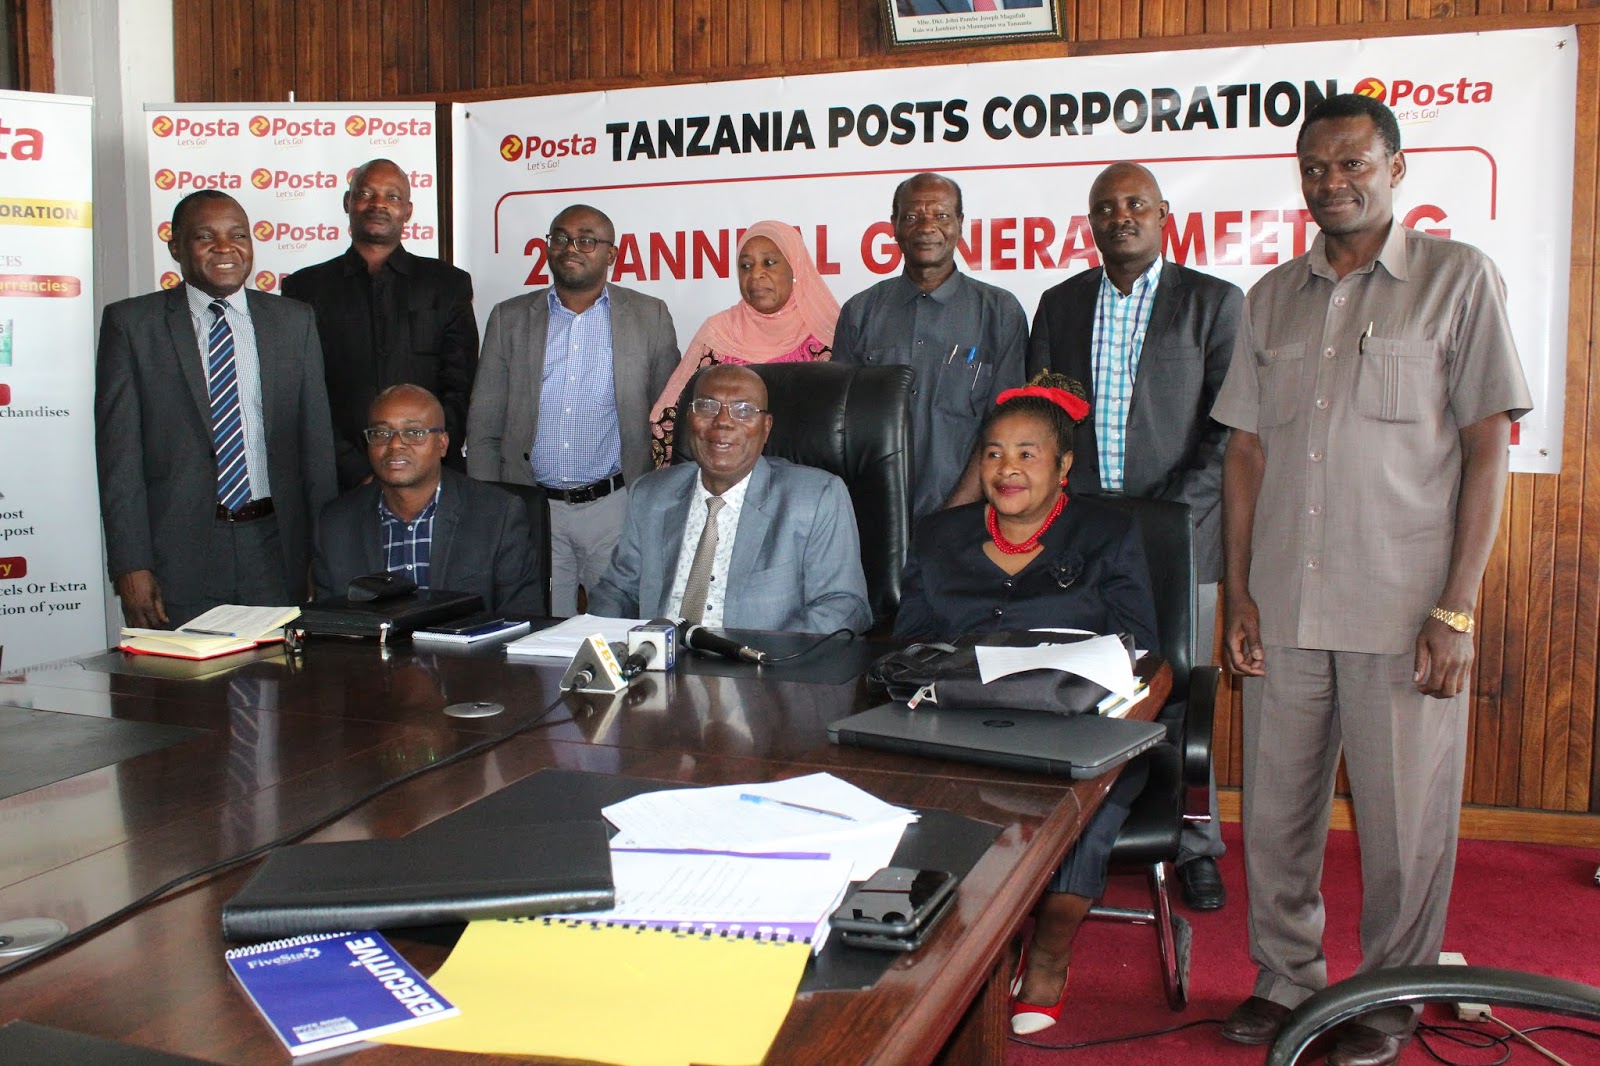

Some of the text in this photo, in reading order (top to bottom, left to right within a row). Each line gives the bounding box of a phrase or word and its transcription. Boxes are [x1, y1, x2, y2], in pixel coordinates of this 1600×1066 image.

[1389, 77, 1494, 107] Posta
[606, 79, 1338, 161] TANZANIA POSTS CORPORATION
[1420, 108, 1440, 119] Go!
[175, 118, 240, 137] Posta
[272, 118, 336, 137] Posta
[368, 117, 432, 136] Posta
[177, 137, 208, 146] Let's Go!
[274, 137, 304, 146] Let's Go!
[369, 137, 400, 146] Let's Go!
[525, 133, 597, 159] Posta
[526, 159, 560, 171] Let's Go!
[178, 171, 242, 190] Posta
[274, 171, 338, 189] Posta
[294, 190, 306, 198] Go!
[0, 204, 79, 220] ORATION
[276, 223, 340, 241] Posta
[400, 221, 435, 241] sta
[296, 242, 308, 250] Go!
[612, 224, 840, 282] ANNL
[861, 214, 1101, 274] GNERA
[1162, 203, 1451, 266] MEETG
[27, 583, 46, 594] Or
[50, 582, 88, 593] Extra
[30, 601, 46, 613] of
[48, 602, 81, 616] your
[594, 638, 623, 677] ZBC
[345, 937, 445, 1017] EXECUTIVE
